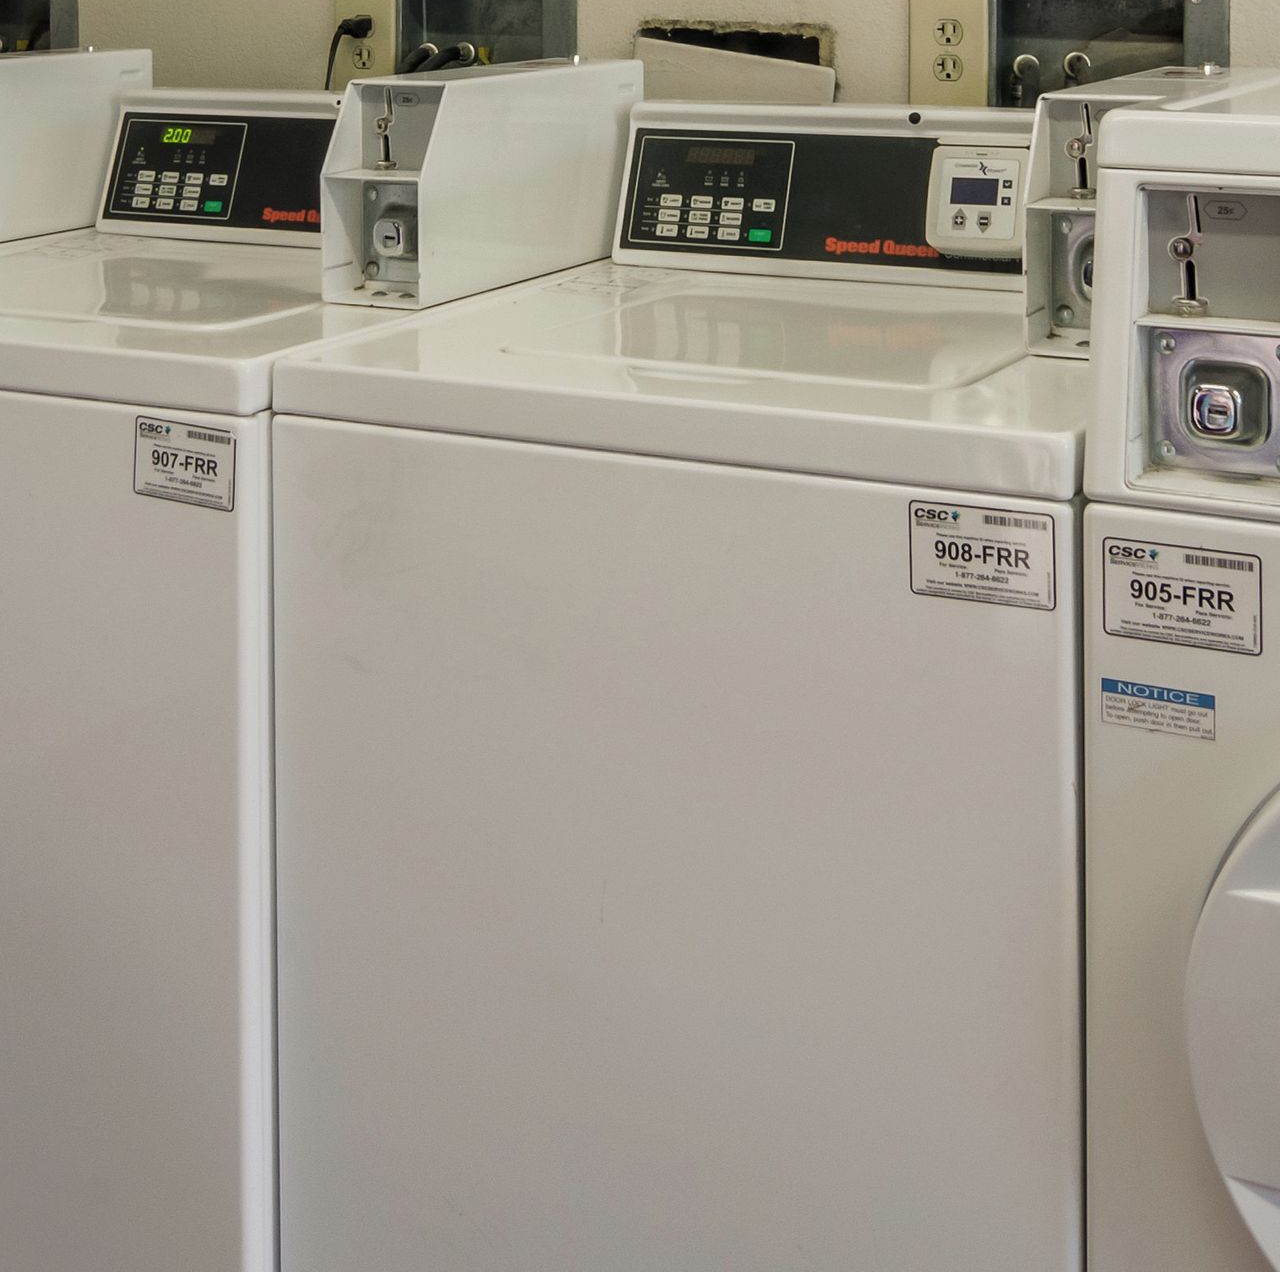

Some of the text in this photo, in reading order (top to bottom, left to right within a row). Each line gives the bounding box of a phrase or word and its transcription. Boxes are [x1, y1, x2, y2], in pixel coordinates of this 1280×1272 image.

[163, 129, 192, 143] 2.00
[262, 208, 305, 222] Speed
[825, 237, 880, 255] Speed
[883, 240, 939, 258] Queen
[139, 422, 163, 434] CSC
[152, 450, 218, 477] 907-FRR
[914, 508, 949, 521] CSC
[934, 540, 1031, 569] 908-FRR
[1108, 546, 1146, 559] CSC
[1130, 579, 1235, 612] 905-FRR
[1118, 682, 1200, 705] NOTICE
